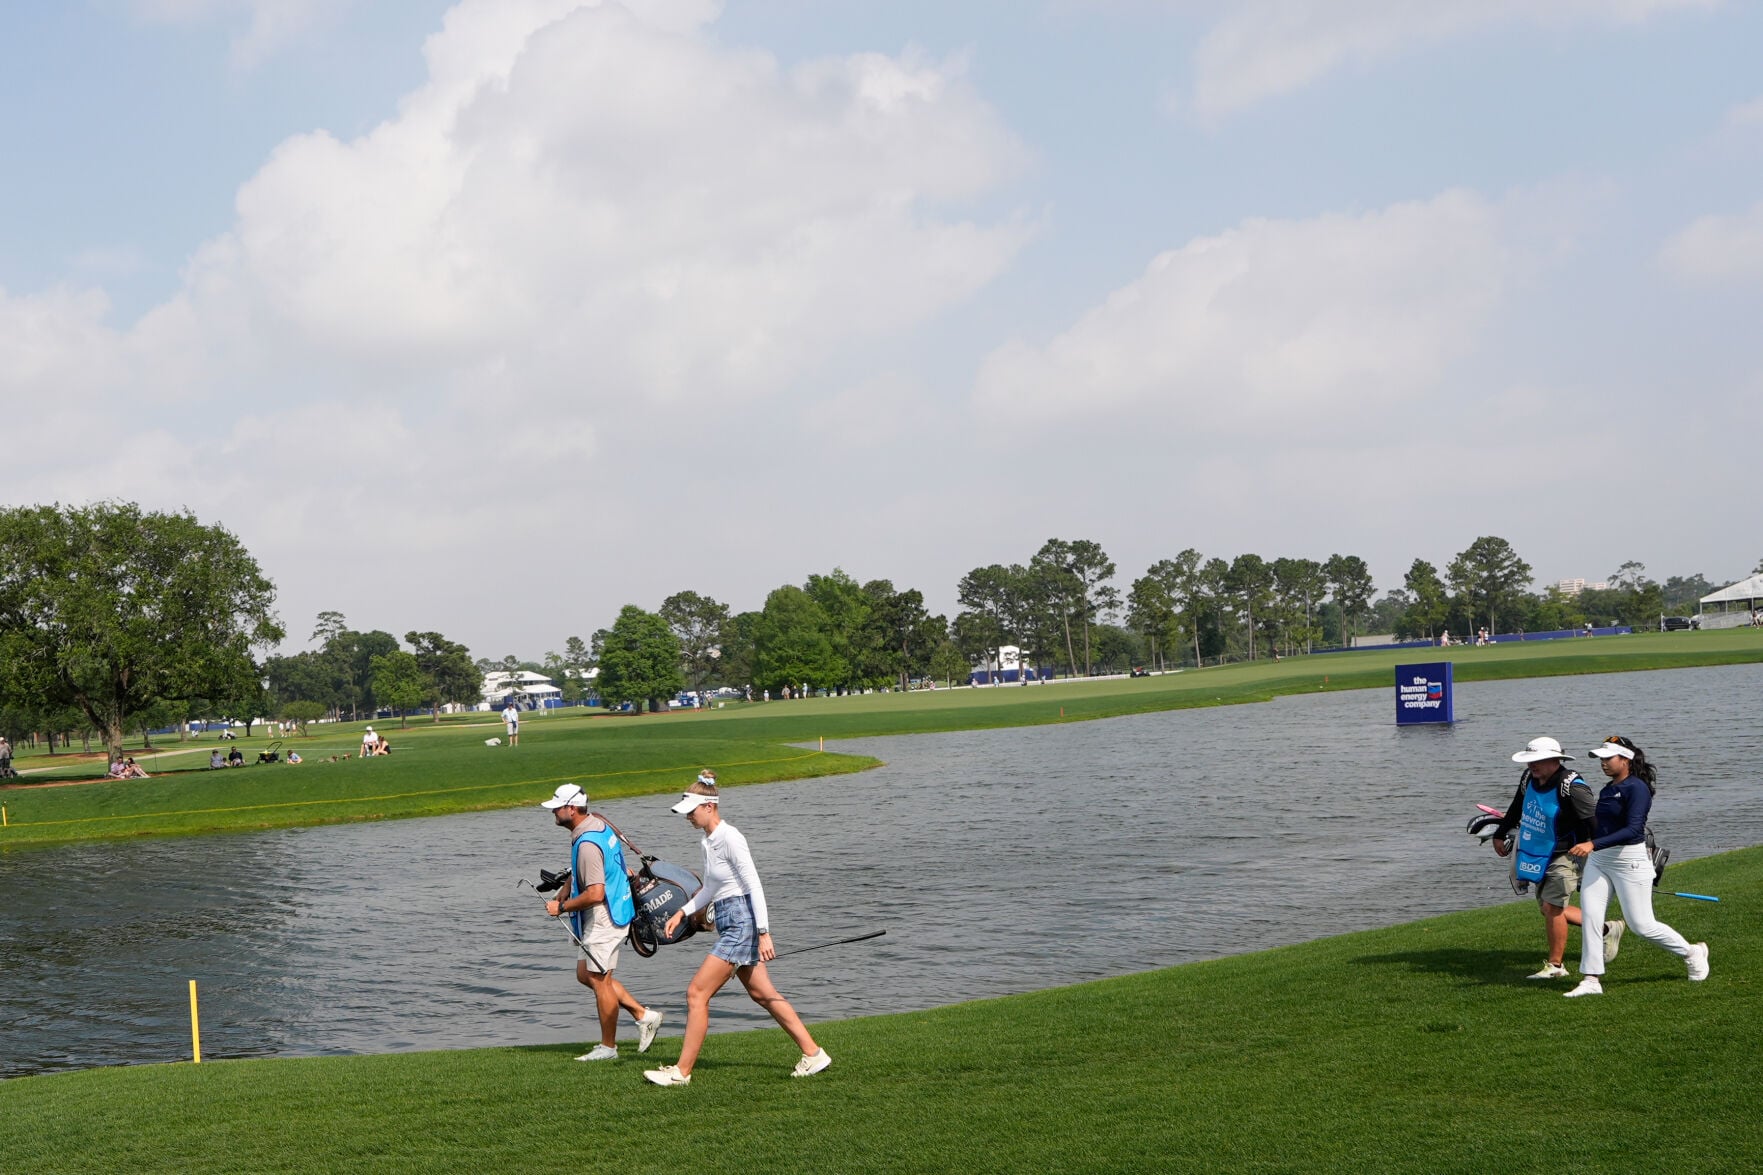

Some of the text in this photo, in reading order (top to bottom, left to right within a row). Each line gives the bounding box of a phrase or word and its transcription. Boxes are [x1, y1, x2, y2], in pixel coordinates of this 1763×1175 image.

[1413, 676, 1427, 685] the
[1400, 685, 1427, 693] human
[1400, 693, 1428, 701] energy
[1404, 700, 1440, 709] company
[1522, 813, 1546, 829] hevron
[1521, 862, 1541, 872] BDO
